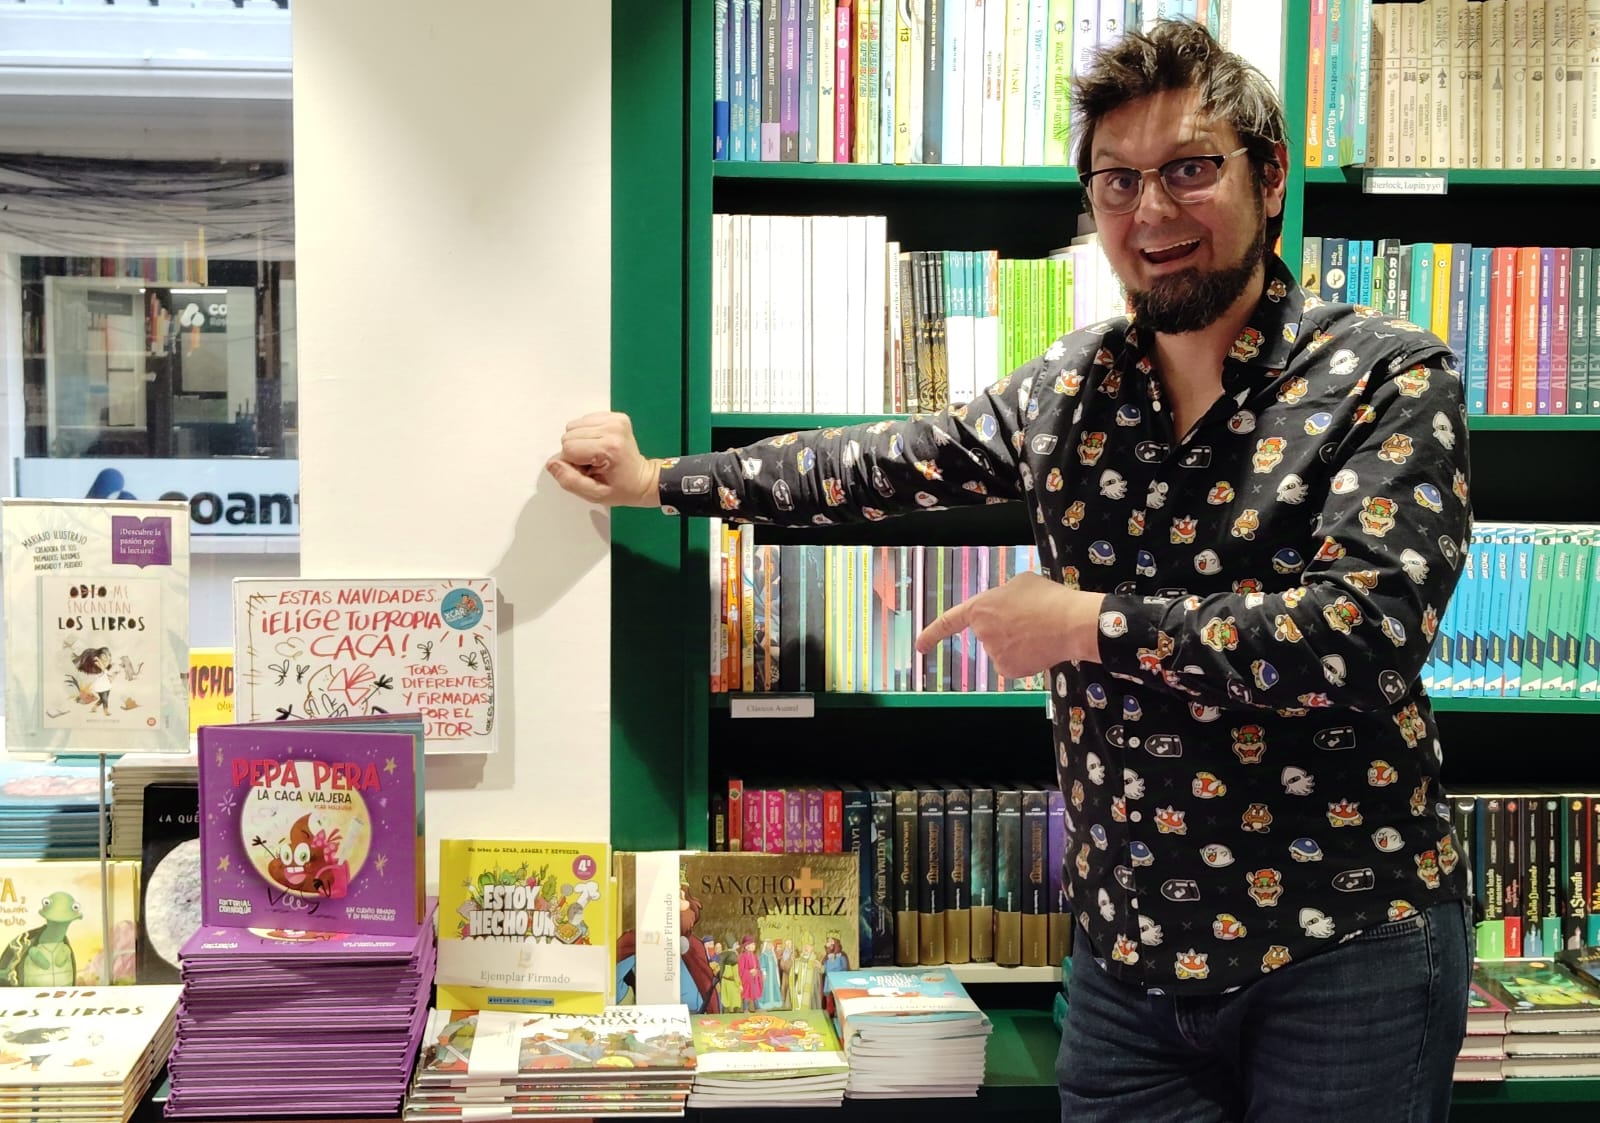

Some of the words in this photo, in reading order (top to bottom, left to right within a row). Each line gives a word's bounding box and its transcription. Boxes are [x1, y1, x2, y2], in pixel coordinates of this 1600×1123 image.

[900, 27, 909, 42] 113
[1360, 43, 1368, 69] SALVAR
[899, 122, 907, 134] 13
[1404, 178, 1425, 192] Lupin
[1472, 353, 1487, 390] ALEX
[1498, 353, 1512, 390] ALEX
[1521, 353, 1537, 390] ALEX
[1552, 353, 1567, 390] ALEX
[1570, 353, 1587, 391] ALEX
[154, 528, 161, 536] la
[120, 538, 142, 547] pasión
[143, 539, 155, 547] por
[127, 546, 154, 554] lectura!
[69, 583, 108, 599] ODIO
[113, 584, 129, 599] ME
[278, 590, 332, 606] ESTAS
[67, 600, 131, 615] ENCANTAN
[58, 615, 83, 630] LOS
[91, 615, 146, 632] LIBROS
[371, 610, 442, 632] PROPIA
[407, 664, 448, 676] TODAS
[402, 676, 488, 689] DIFERENTES
[402, 692, 414, 706] Y
[419, 707, 448, 719] POR
[454, 708, 473, 719] EL
[423, 721, 473, 737] UTOR
[231, 758, 301, 789] PEPA
[312, 761, 382, 793] PERA
[257, 789, 270, 801] LA
[274, 790, 303, 802] CACA
[308, 791, 353, 805] VIAJERA
[158, 814, 173, 824] ¿A
[177, 812, 200, 824] QUÉ
[851, 828, 860, 840] LA
[878, 829, 886, 841] LA
[877, 842, 886, 873] ÚLTIMA
[701, 874, 796, 896] SANCHO
[878, 874, 887, 901] BRUJA
[1570, 871, 1585, 907] Sirenita
[483, 885, 542, 911] ESTOY
[664, 893, 673, 935] Firmado
[1571, 907, 1584, 919] La
[468, 910, 529, 936] HECHO
[531, 910, 556, 937] UN
[664, 937, 675, 982] Ejemplar
[480, 970, 524, 984] Ejemplar
[527, 973, 571, 984] Firmado
[35, 989, 97, 999] ODIO
[55, 1006, 145, 1018] LIBROS
